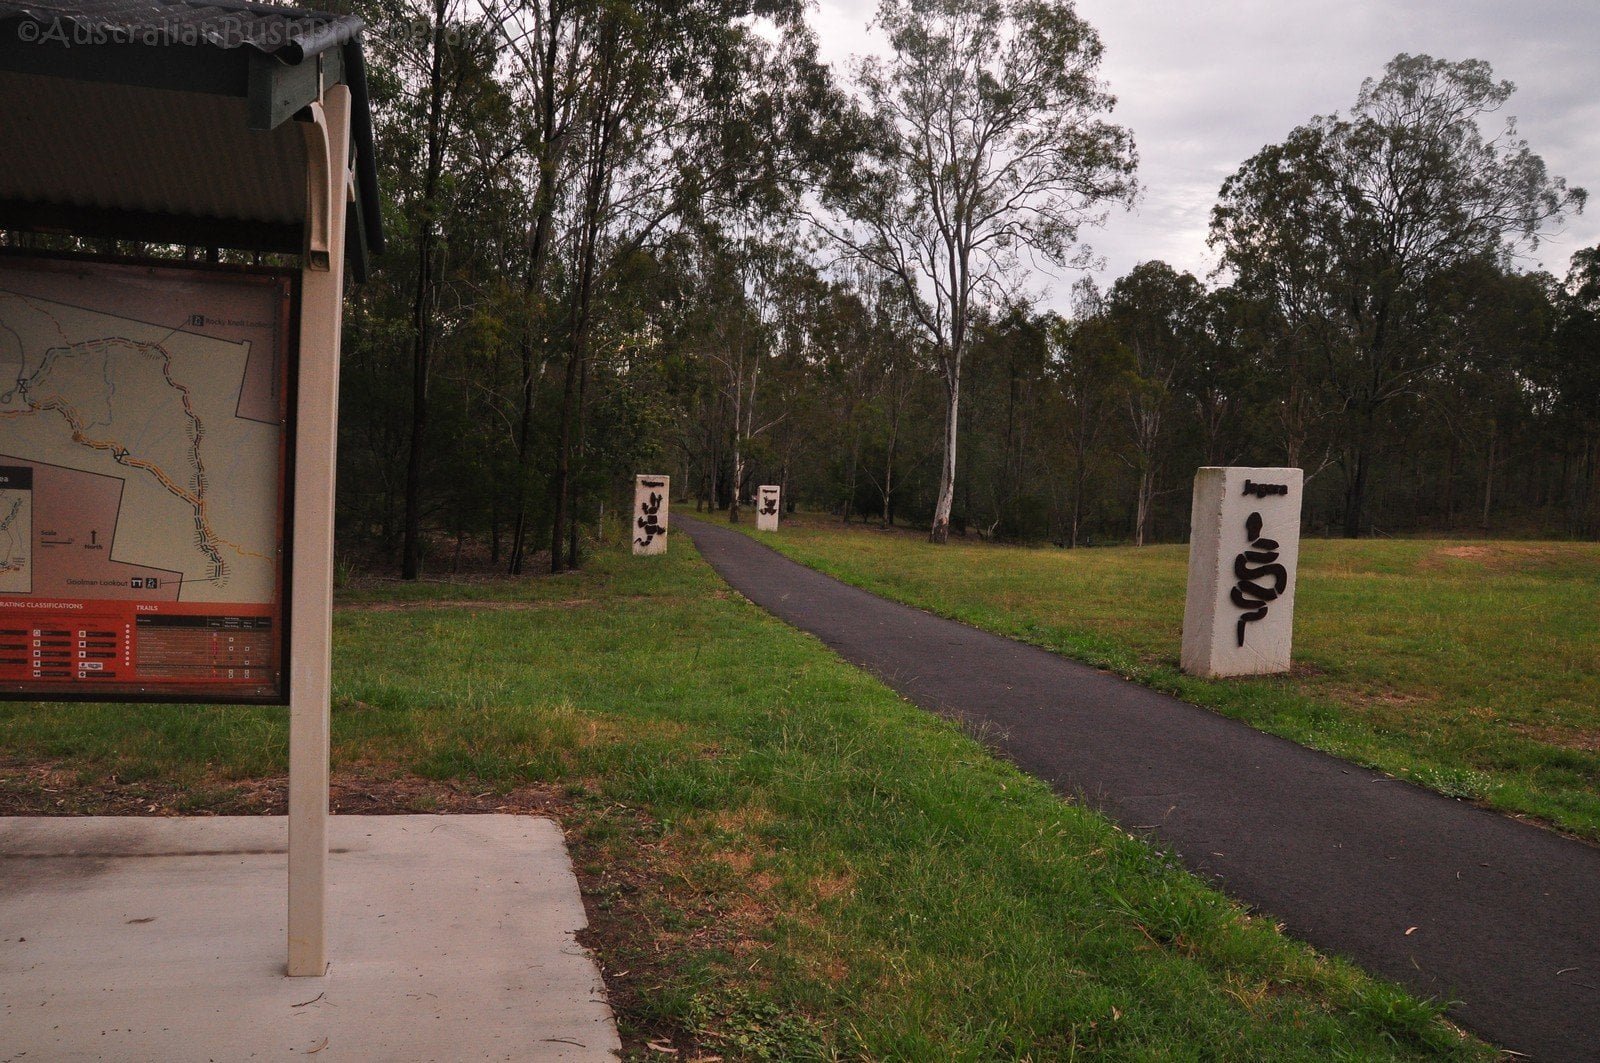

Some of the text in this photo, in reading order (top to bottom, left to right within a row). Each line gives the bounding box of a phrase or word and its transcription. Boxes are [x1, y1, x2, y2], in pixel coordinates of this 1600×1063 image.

[227, 319, 245, 327] Knoll
[66, 578, 128, 587] Goolman Lookout
[26, 602, 84, 610] CLASSIFICATIONS
